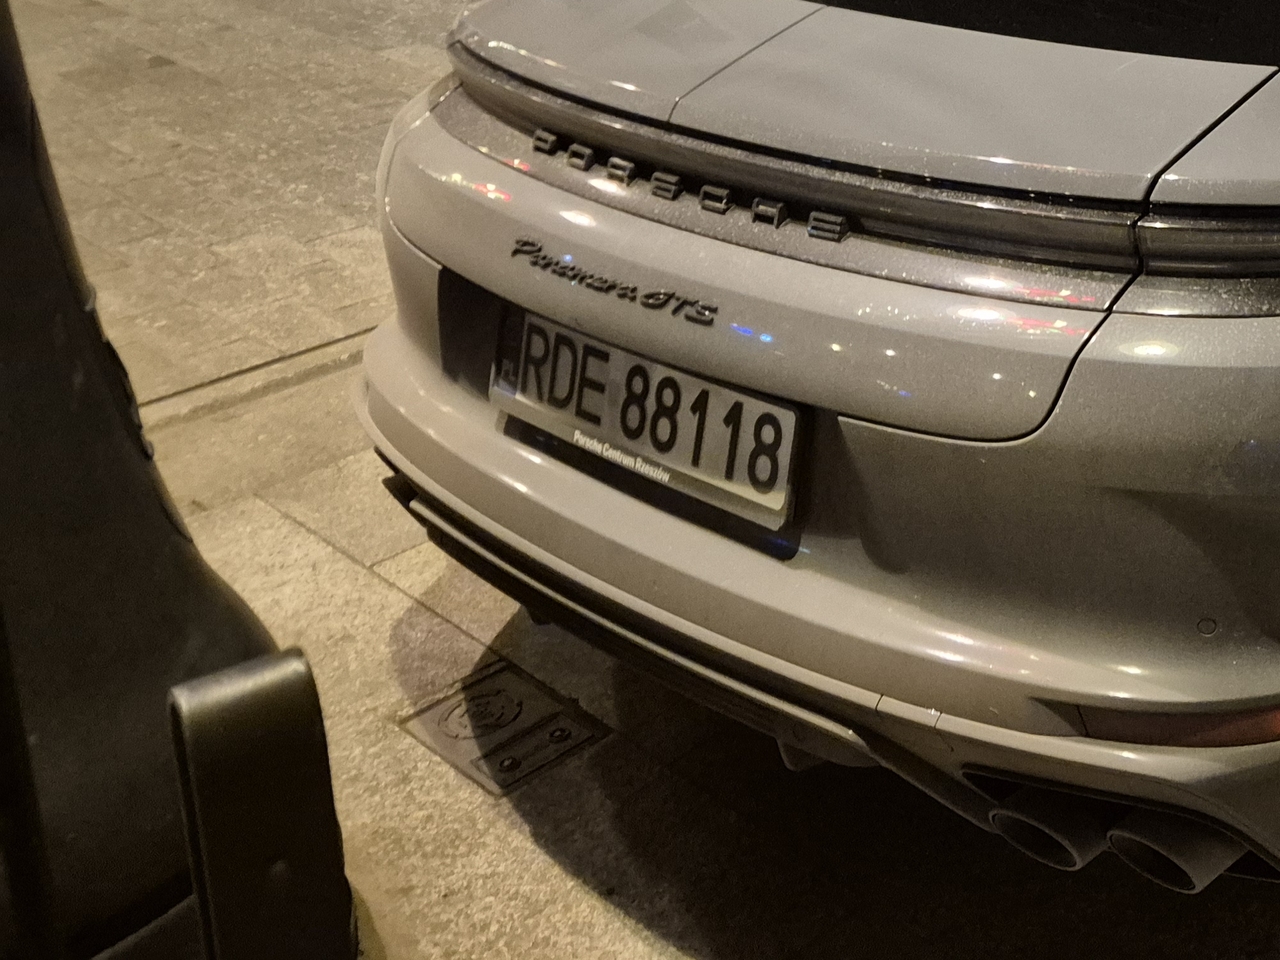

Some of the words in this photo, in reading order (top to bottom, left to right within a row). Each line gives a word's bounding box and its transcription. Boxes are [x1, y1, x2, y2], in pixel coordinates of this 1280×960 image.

[532, 129, 848, 243] PORSCHE
[511, 239, 637, 303] Panamera
[640, 291, 718, 326] GTS
[520, 322, 610, 426] RDE
[619, 364, 783, 494] 88118
[574, 430, 603, 455] Porsche
[603, 443, 635, 469] Centrum
[635, 456, 670, 483] Rzeszów
